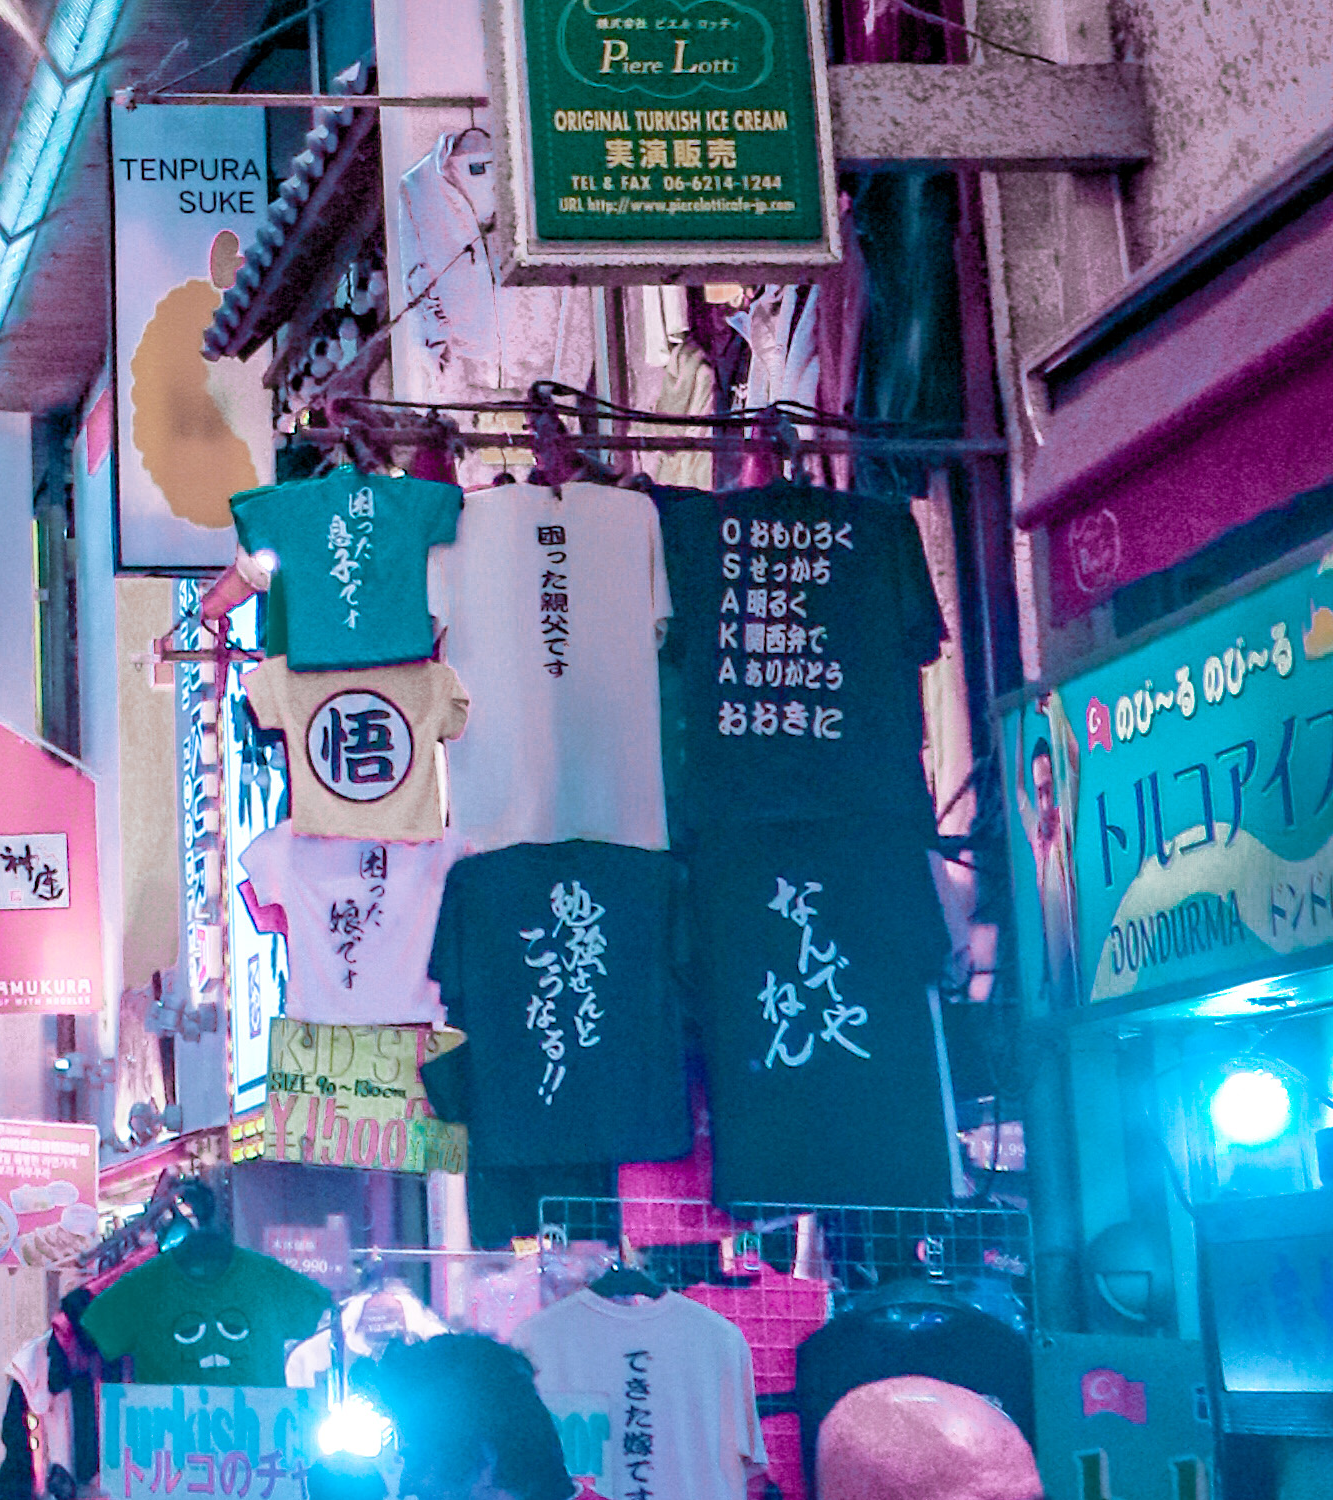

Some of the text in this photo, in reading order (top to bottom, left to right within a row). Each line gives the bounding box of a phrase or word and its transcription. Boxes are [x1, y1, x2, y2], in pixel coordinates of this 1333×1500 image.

[599, 39, 739, 73] Piere Lotti
[554, 110, 787, 131] ORIGINAL TURKISH ICE CREAM
[119, 156, 261, 184] TENPURA
[605, 138, 737, 169] 実演販売
[571, 176, 596, 190] TEL
[621, 176, 651, 190] FAX
[663, 175, 782, 191] 06-6214-1244
[178, 188, 256, 216] SUKE
[349, 487, 375, 560] 困った
[722, 518, 853, 550] O おもしろく
[723, 552, 831, 585] S せっかち
[537, 525, 570, 679] 困った親父です
[721, 587, 807, 618] A 明るく
[720, 621, 828, 653] K 関西弁で
[719, 656, 844, 691] A ありがとう
[719, 701, 844, 739] おおきに
[320, 708, 395, 783] 悟
[359, 847, 387, 928] 困った
[1272, 870, 1333, 937] ドンド
[1111, 888, 1245, 976] DONDURMA
[550, 880, 607, 1048] 勉強せんと
[270, 1072, 314, 1094] SIZE
[100, 1385, 262, 1469] Turkish
